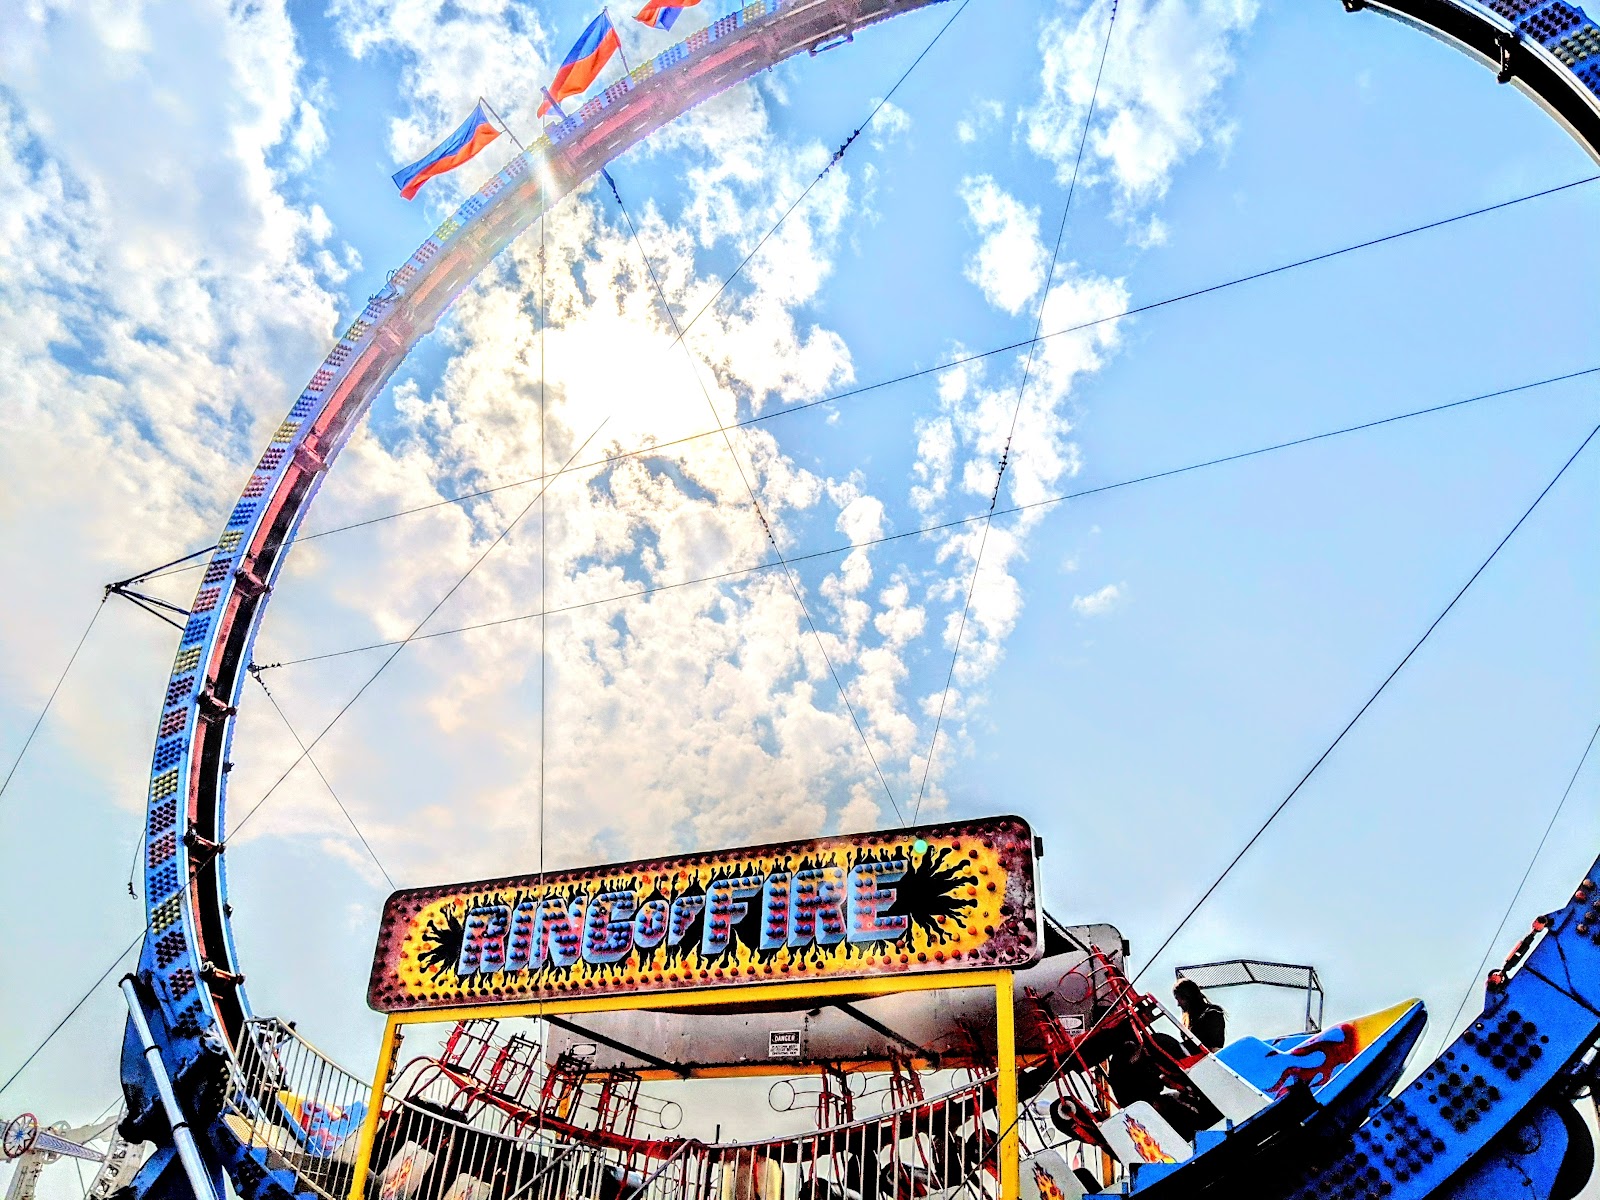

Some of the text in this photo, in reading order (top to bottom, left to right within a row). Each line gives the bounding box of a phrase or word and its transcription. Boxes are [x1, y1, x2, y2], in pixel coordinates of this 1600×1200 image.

[458, 890, 638, 976] RING
[702, 859, 909, 955] FIRE
[774, 1034, 796, 1042] DANGER
